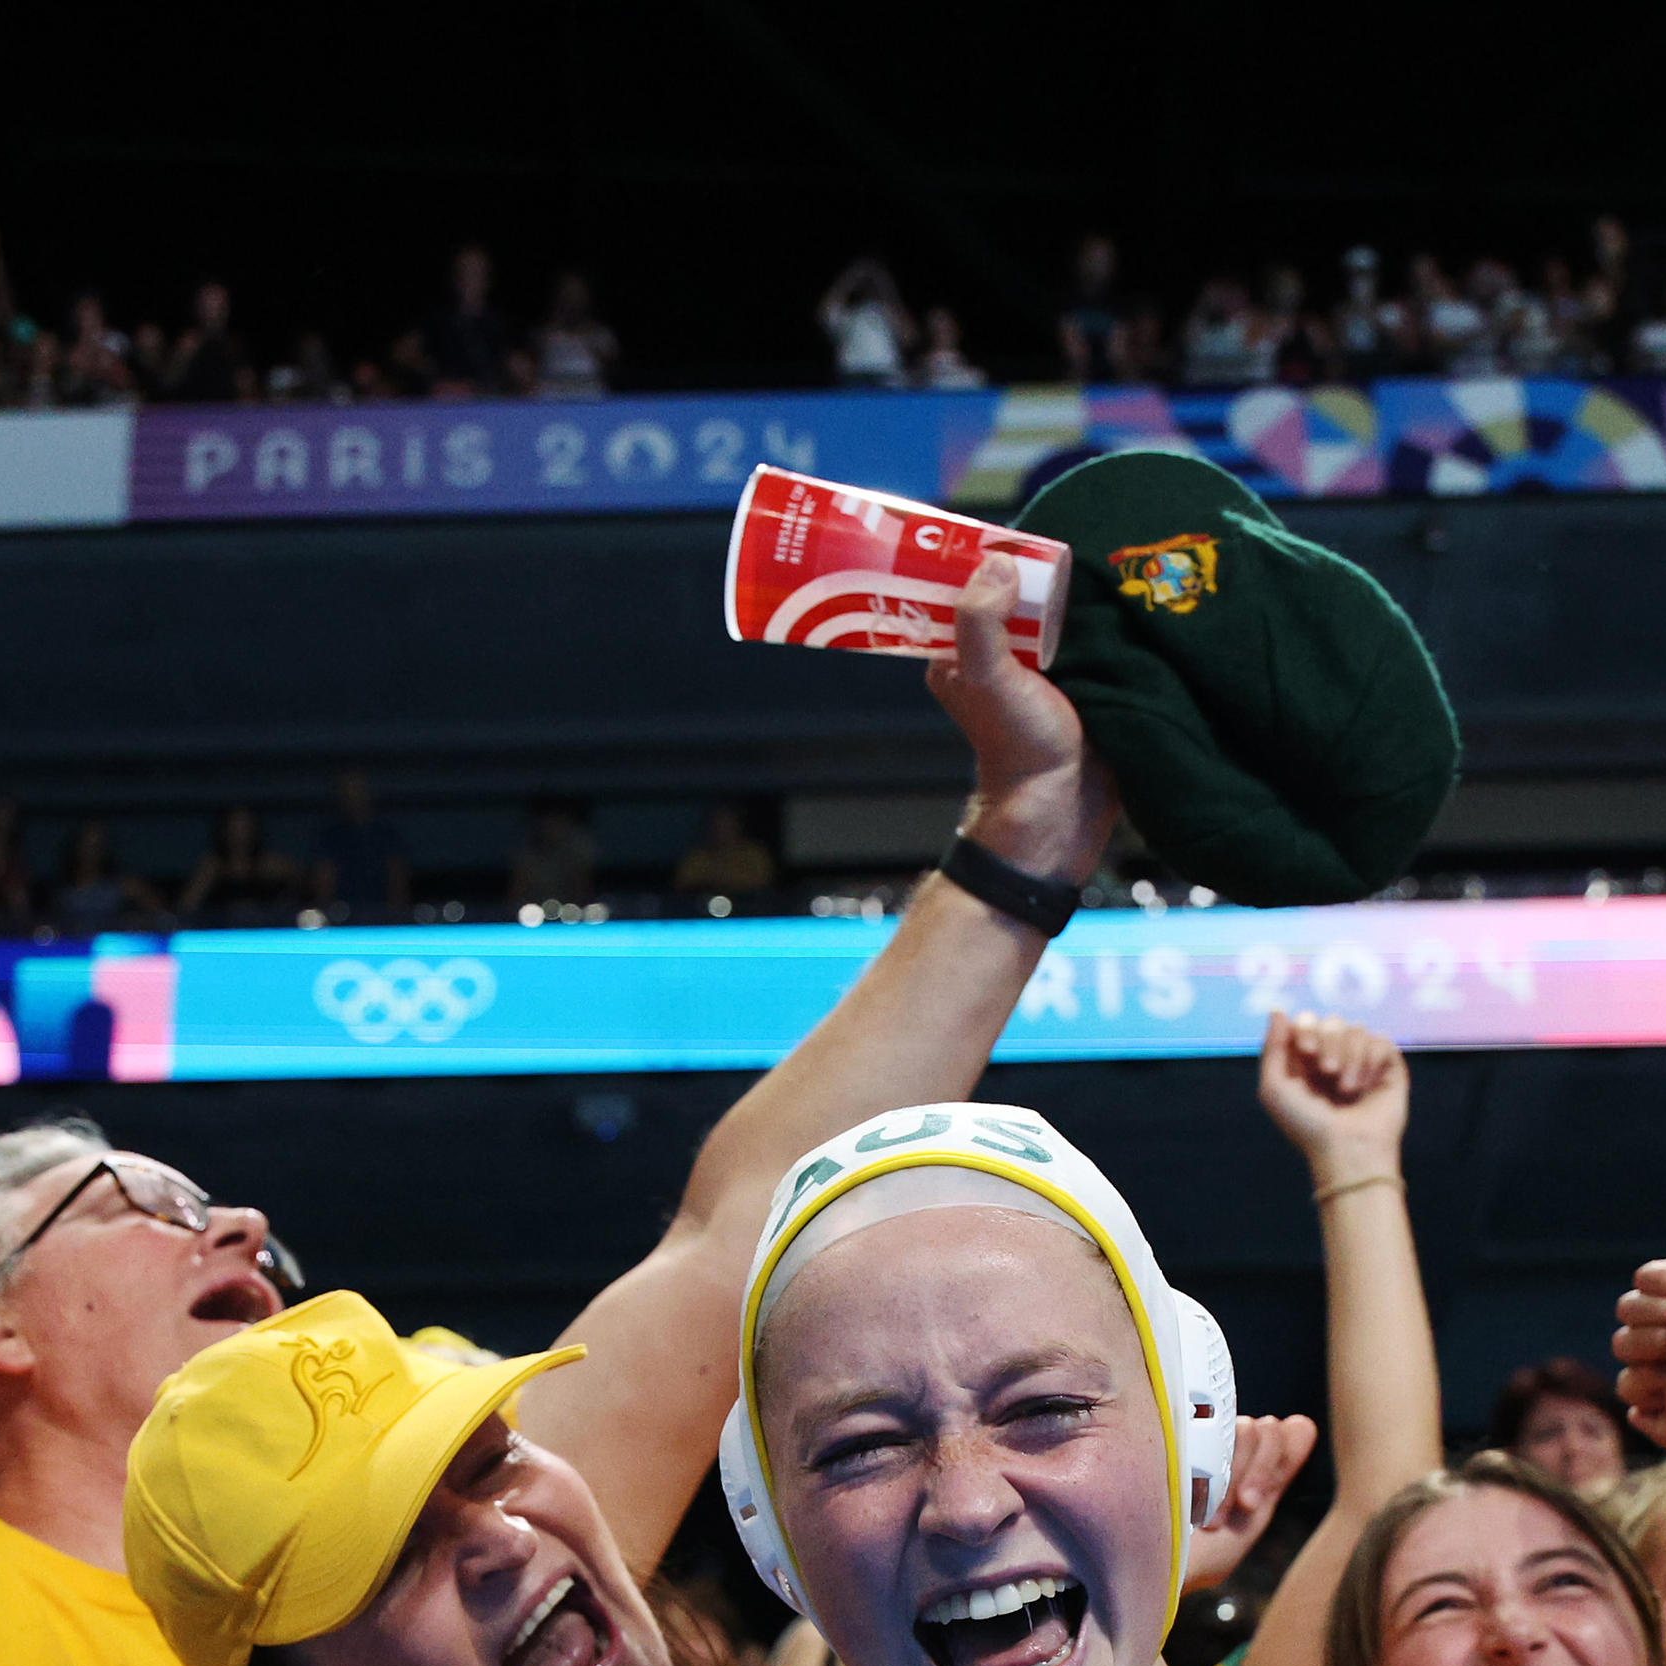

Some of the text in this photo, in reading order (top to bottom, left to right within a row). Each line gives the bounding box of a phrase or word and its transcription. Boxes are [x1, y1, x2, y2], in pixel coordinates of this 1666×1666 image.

[184, 418, 818, 493] PARIS 2024
[1235, 936, 1537, 1013] 2024
[770, 1112, 1053, 1242] AUS
